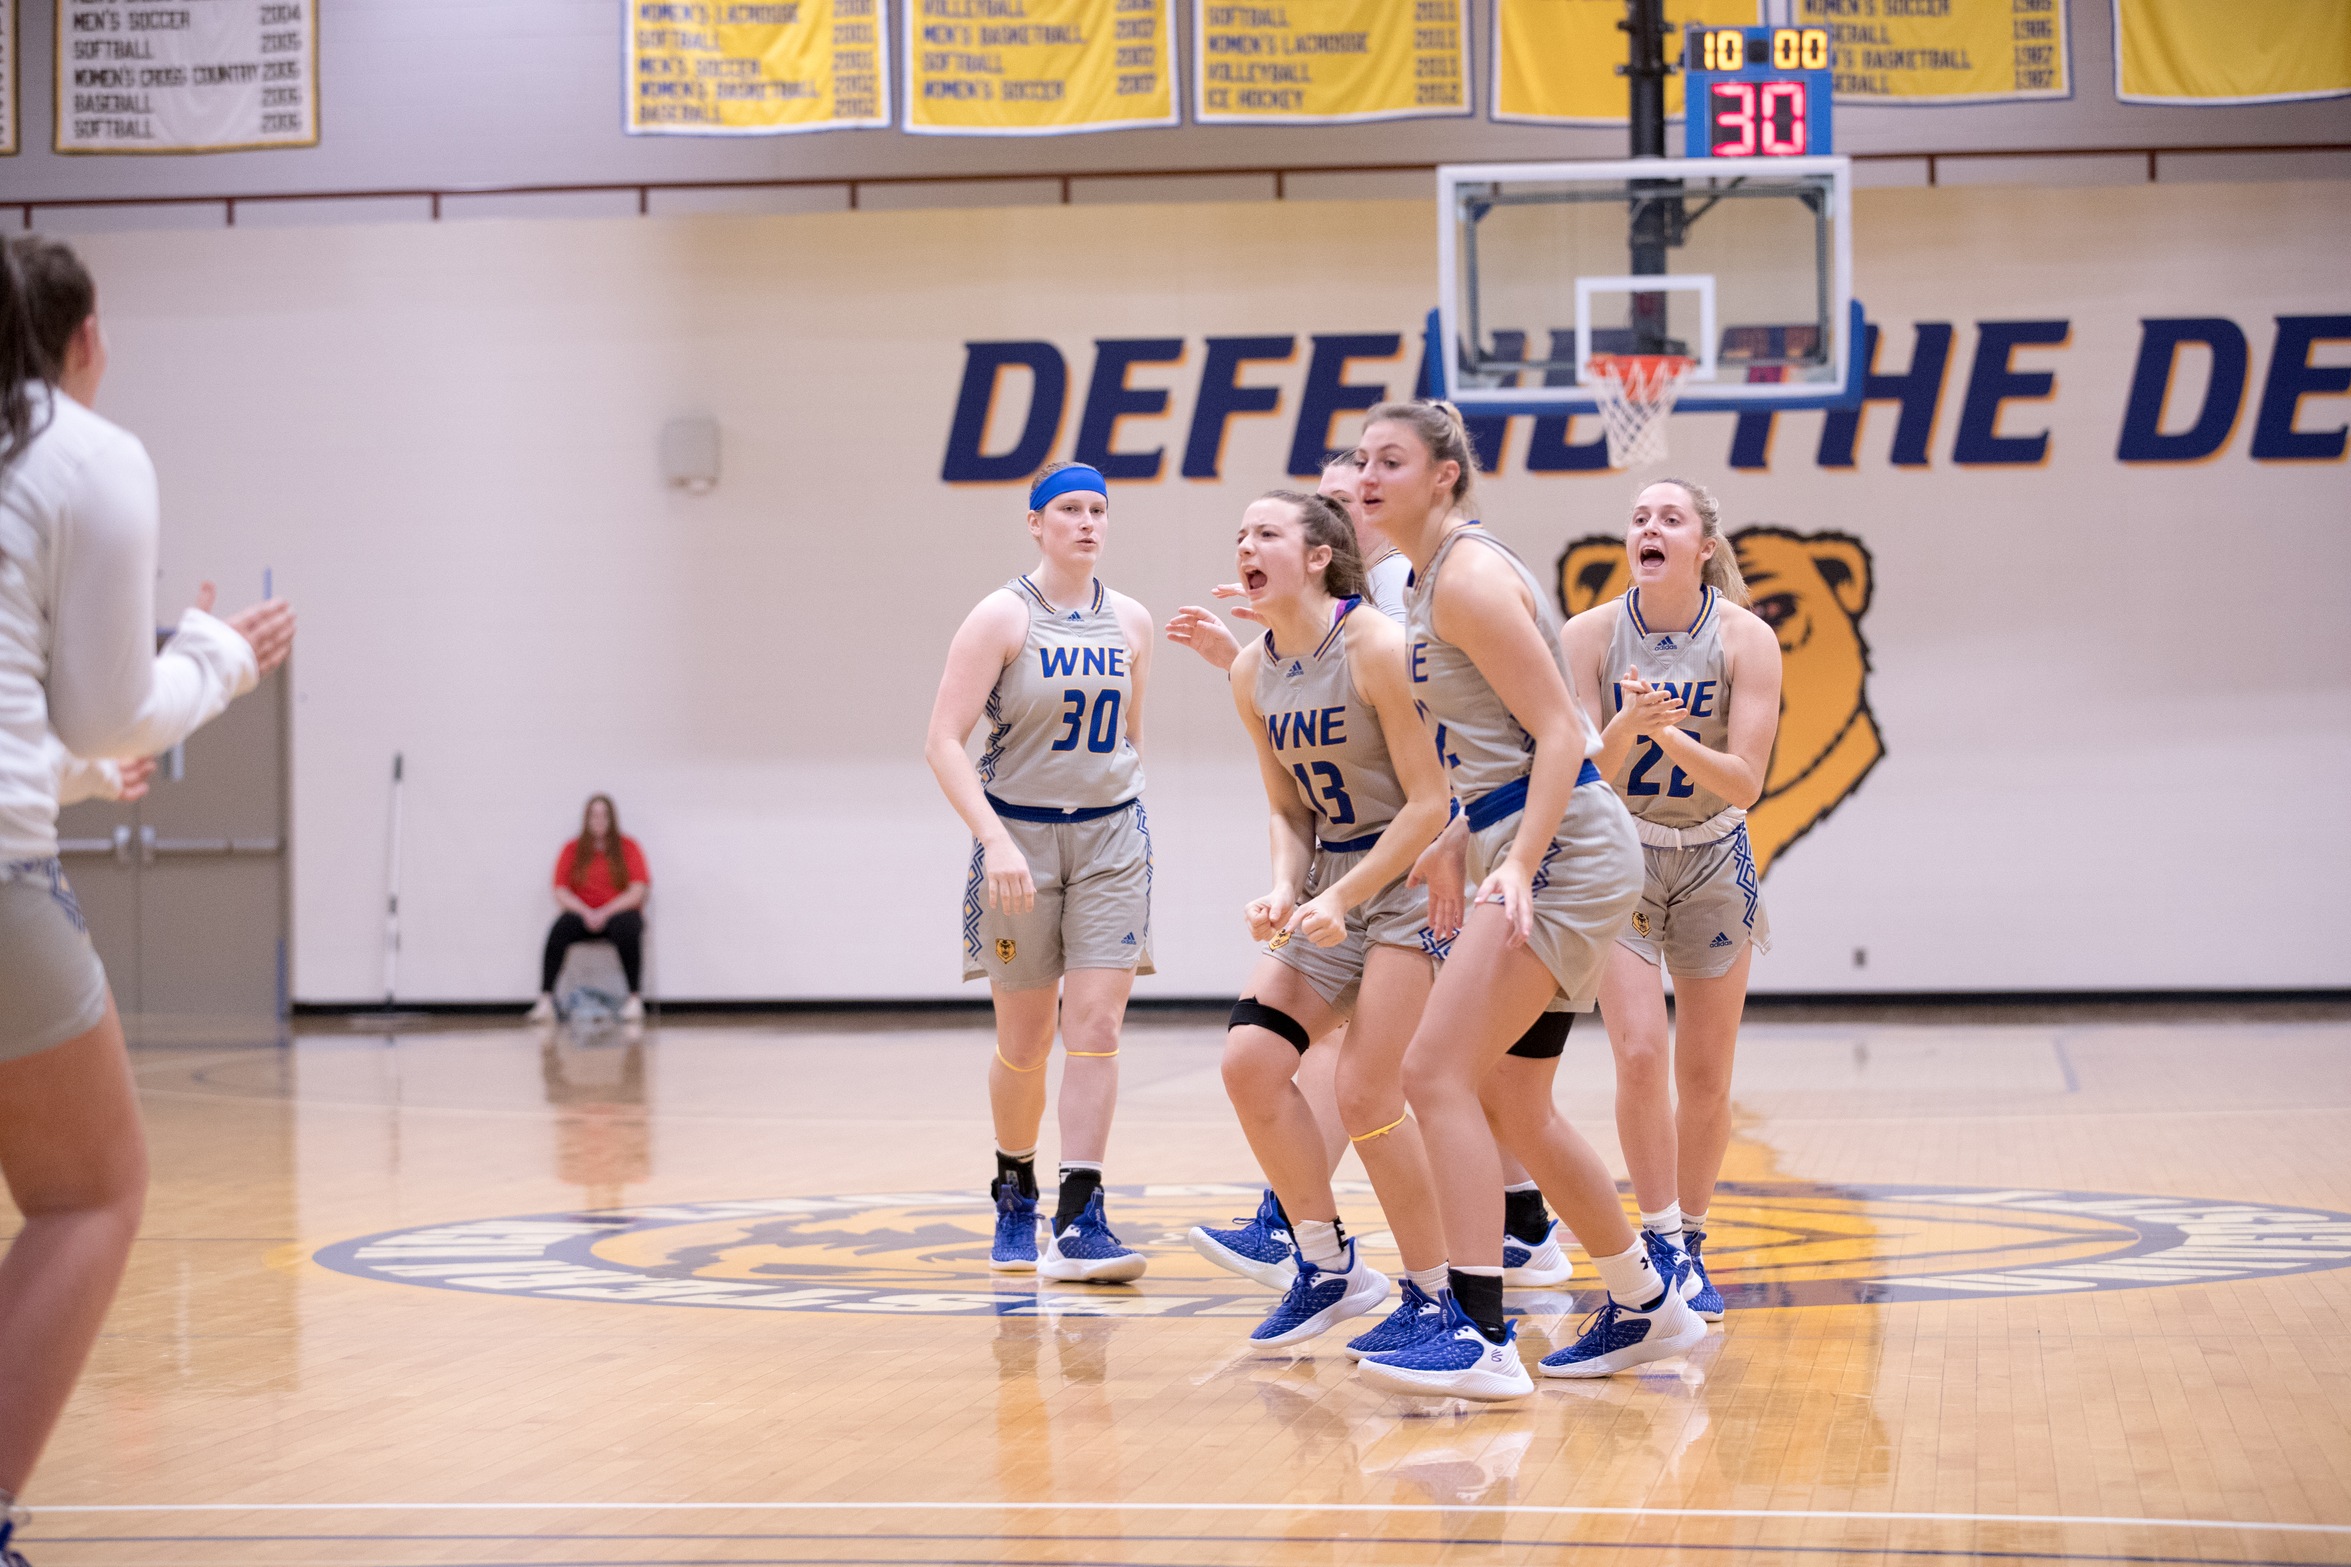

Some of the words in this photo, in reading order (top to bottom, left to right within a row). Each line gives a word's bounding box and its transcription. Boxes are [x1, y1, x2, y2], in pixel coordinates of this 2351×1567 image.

[73, 9, 120, 31] MEN'S
[128, 10, 190, 31] SOCCER
[1832, 23, 1890, 45] EBALL
[73, 39, 154, 60] SOFTBALL
[1704, 29, 1743, 70] 10
[1774, 29, 1828, 70] 00
[73, 66, 135, 88] WOMEN'S
[139, 66, 188, 88] CROSS
[192, 62, 259, 86] COUNTRY
[1833, 72, 1890, 94] EBALL
[73, 93, 154, 114] BASEBALL
[73, 118, 154, 140] SOFTBALL
[1711, 81, 1807, 157] 30
[1039, 646, 1125, 678] WNE
[1051, 688, 1122, 754] 30
[1263, 705, 1347, 751] WNE
[1293, 760, 1355, 825] 13
